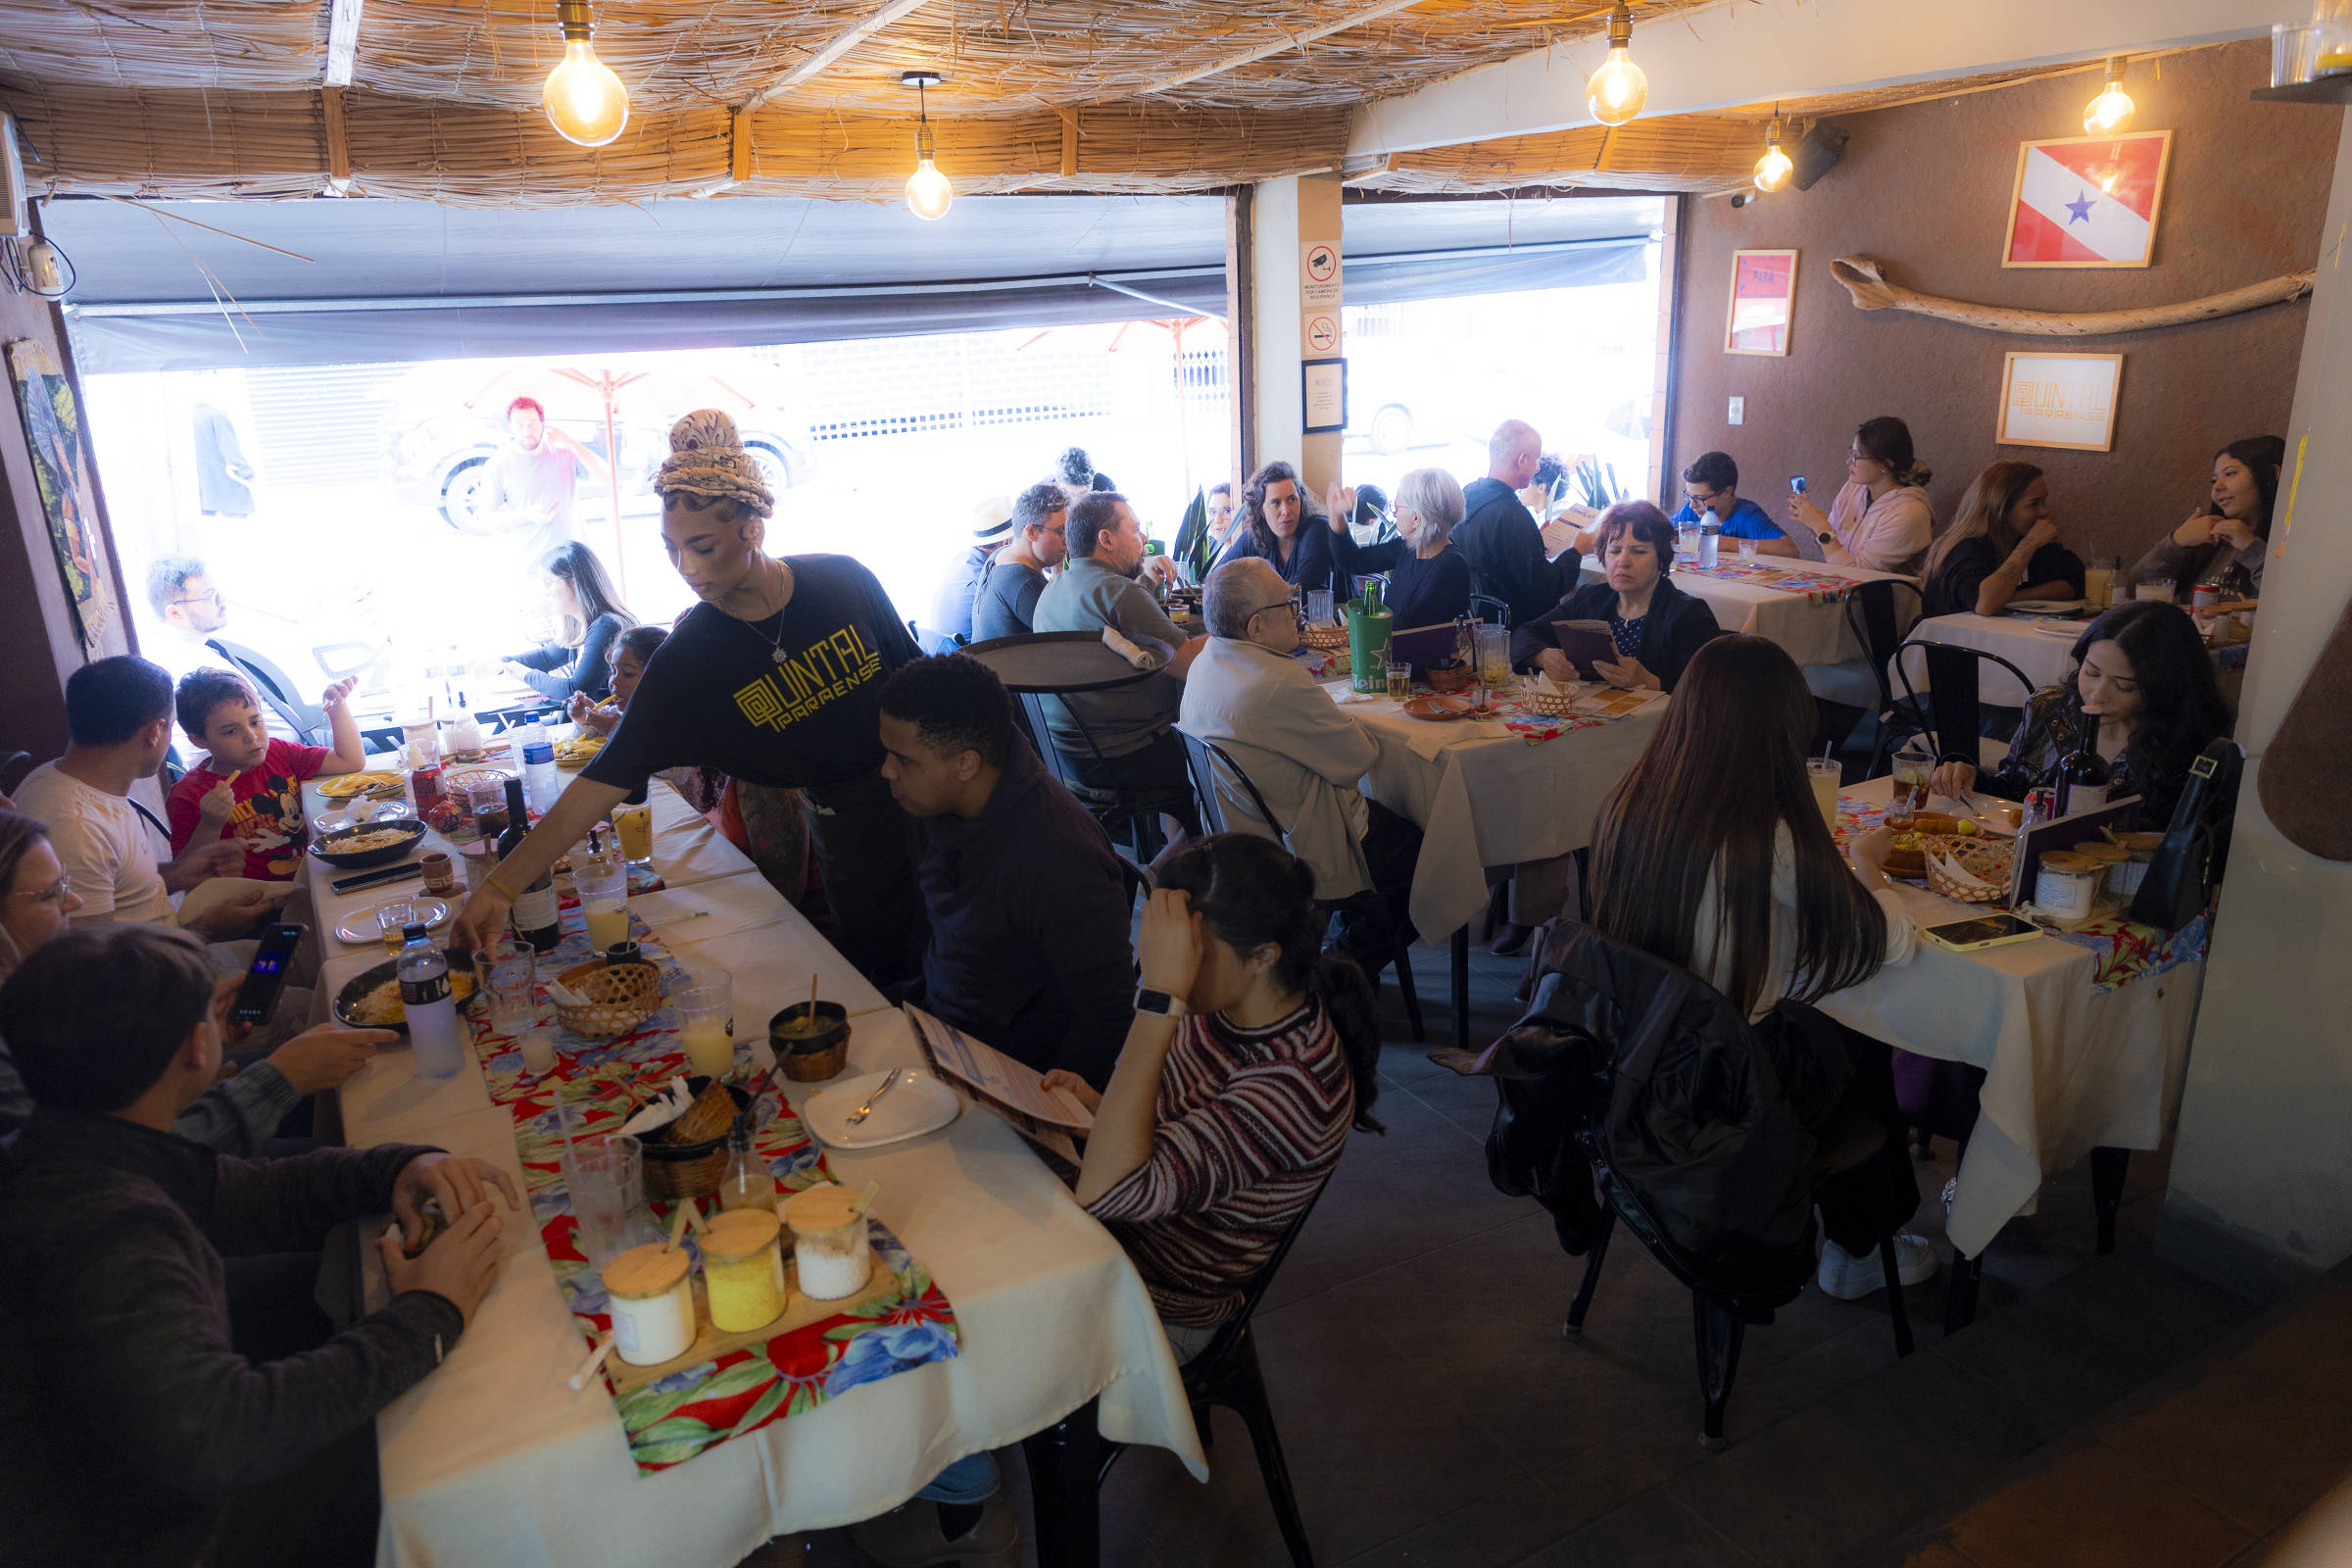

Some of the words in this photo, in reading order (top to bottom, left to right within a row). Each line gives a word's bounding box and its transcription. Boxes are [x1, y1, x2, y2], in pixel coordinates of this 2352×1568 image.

[2013, 380, 2106, 416] QUINTAL
[2023, 408, 2106, 423] PARAENSE
[732, 624, 879, 732] QUINTAL
[776, 658, 882, 729] PARAENSE
